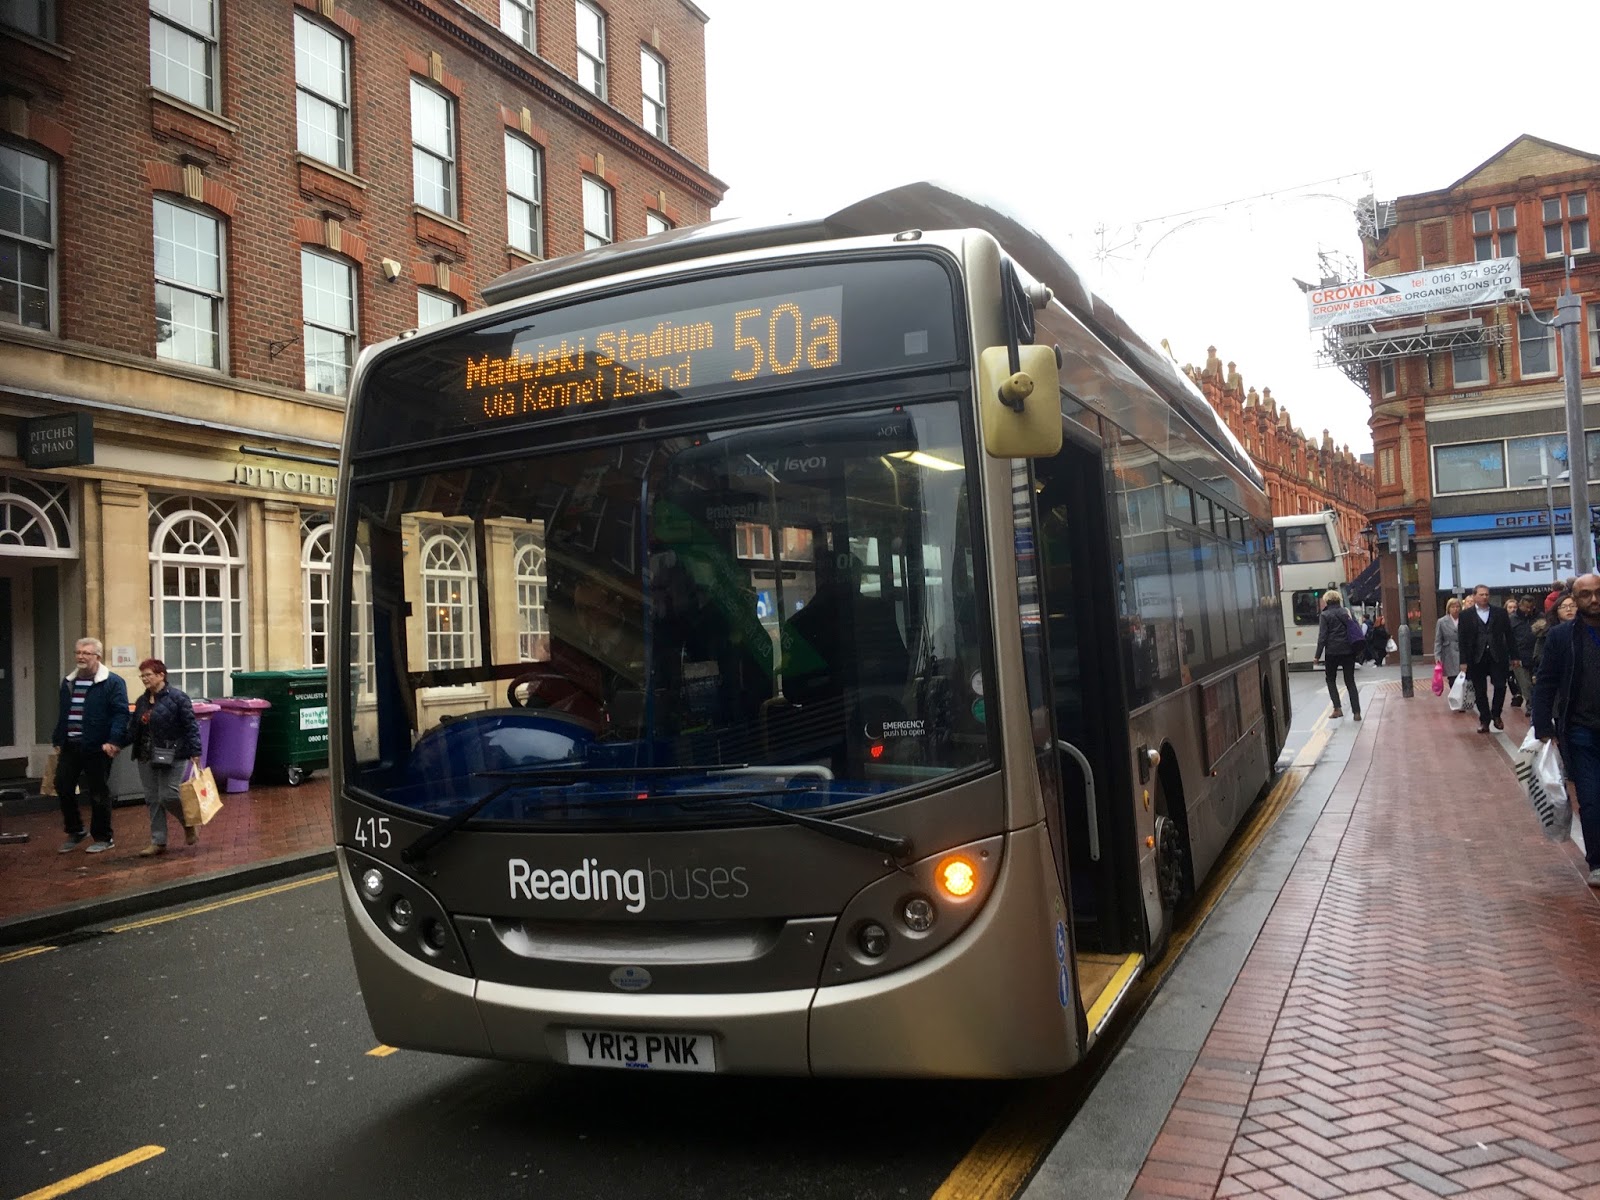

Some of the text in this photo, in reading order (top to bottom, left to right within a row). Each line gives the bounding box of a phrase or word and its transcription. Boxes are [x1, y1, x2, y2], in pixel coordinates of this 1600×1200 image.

[1432, 273, 1456, 285] 0161
[1460, 269, 1479, 281] 371
[1483, 263, 1511, 276] 9524
[1312, 282, 1376, 304] CROWN
[1313, 301, 1350, 315] CROWN
[1353, 294, 1402, 309] SERVICES
[1404, 280, 1490, 300] ORGANISATIONS
[1492, 276, 1512, 286] LTD
[465, 319, 715, 391] Madejski Stadium
[731, 301, 841, 382] 50a
[482, 356, 692, 419] via Kennet Island
[30, 426, 75, 442] PITCHER
[31, 439, 74, 455] & PIANO
[882, 720, 925, 730] EMERGENCY
[883, 729, 926, 739] push to open
[355, 816, 392, 849] 415
[582, 1032, 699, 1065] YR13 PNK
